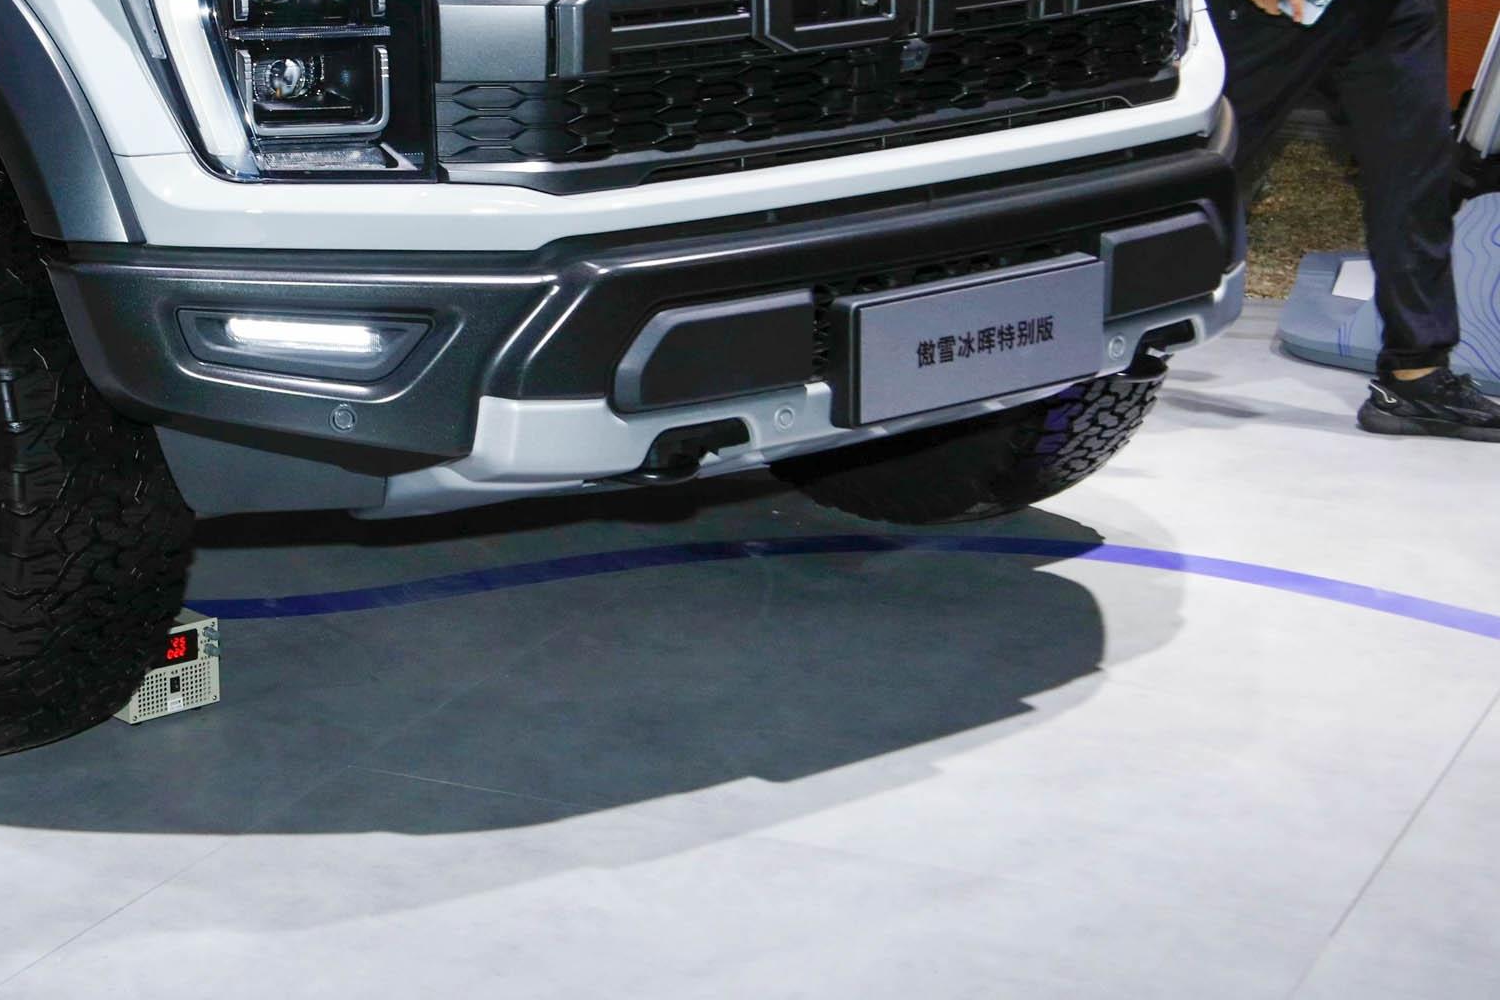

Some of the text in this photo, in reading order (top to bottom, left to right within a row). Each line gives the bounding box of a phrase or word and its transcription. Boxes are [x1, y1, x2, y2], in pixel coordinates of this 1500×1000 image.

[917, 316, 1054, 368] 傲雪冰晖特别版
